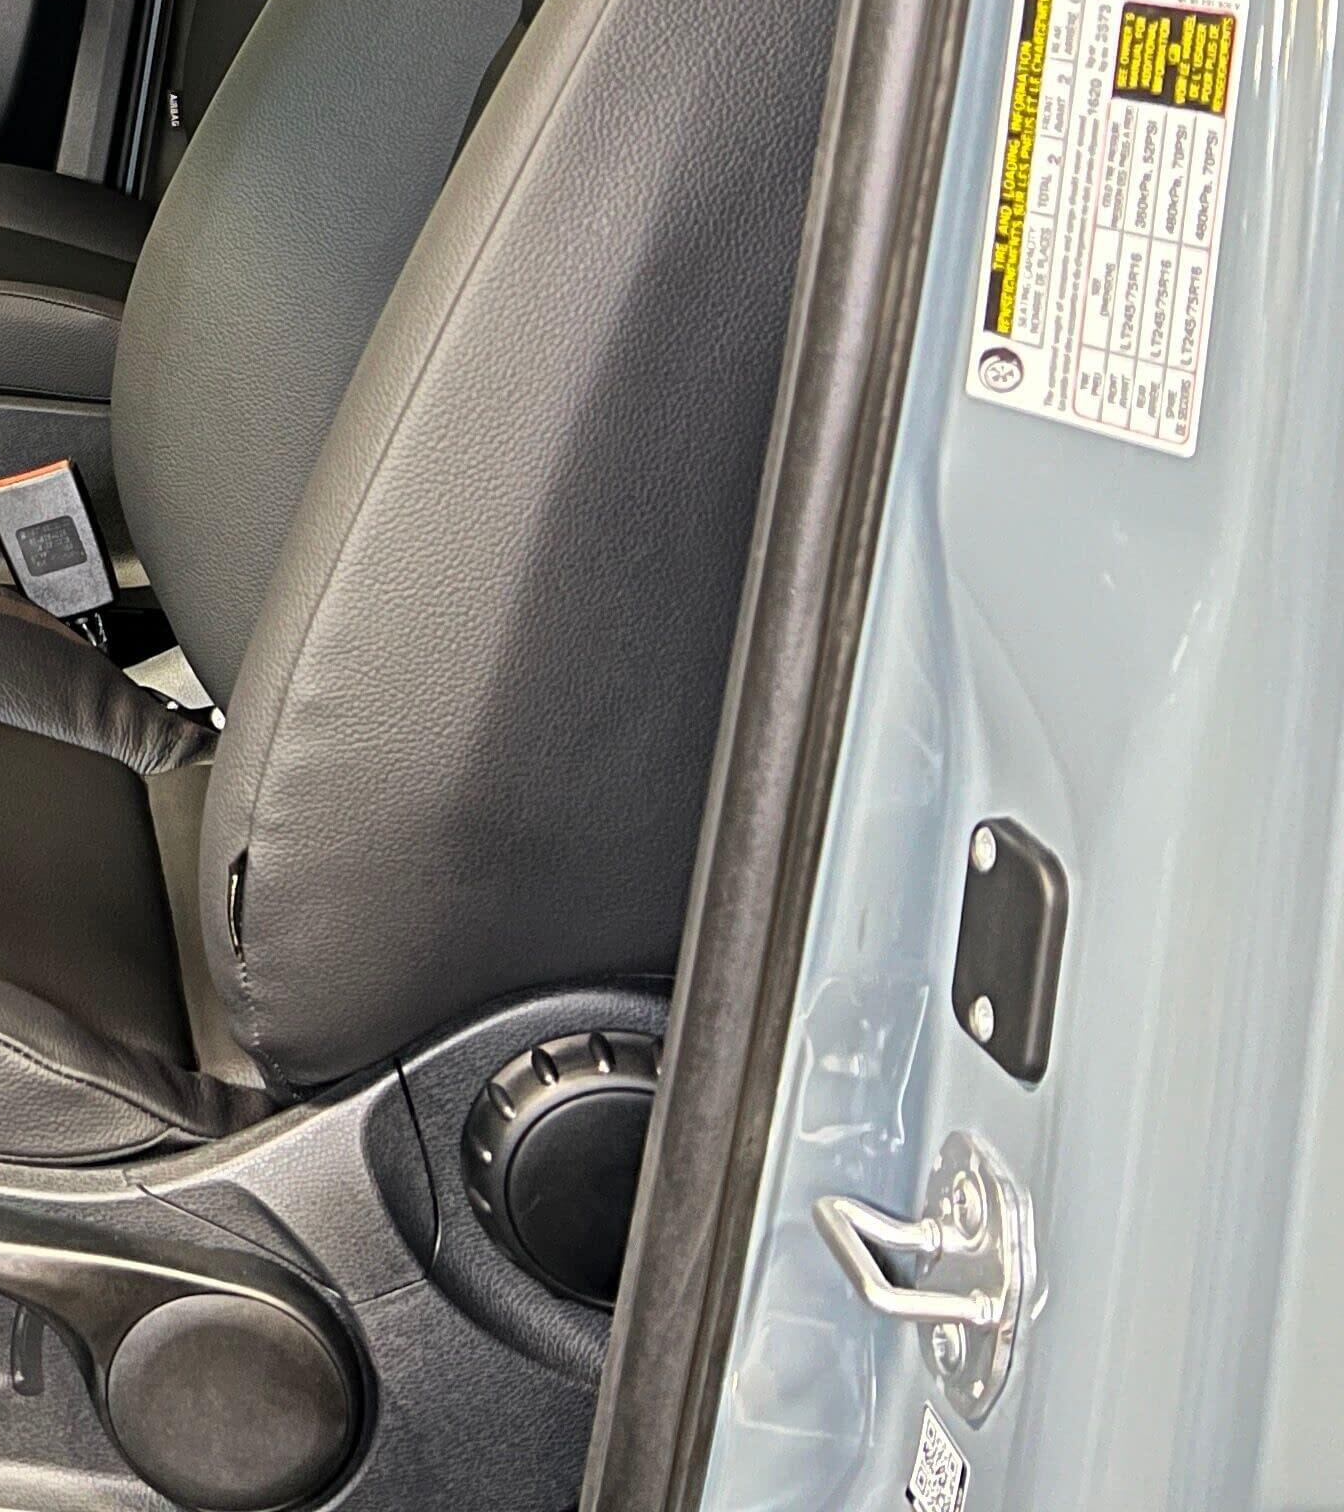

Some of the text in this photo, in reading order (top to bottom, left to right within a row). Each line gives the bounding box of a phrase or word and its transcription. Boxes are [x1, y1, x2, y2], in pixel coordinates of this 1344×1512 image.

[1133, 16, 1146, 39] FOR
[1027, 76, 1040, 92] LE
[1057, 73, 1071, 85] 2
[1200, 23, 1219, 102] POUR PLUS DE
[169, 93, 180, 127] AIRBAG
[1025, 95, 1038, 113] ET
[1085, 77, 1102, 116] 1620
[992, 40, 1032, 271] TIRE AND LOADING INFORMATION
[1019, 116, 1035, 159] PNEUS
[1142, 119, 1158, 164] 52PSI
[1171, 124, 1188, 169] 70PSI
[1202, 129, 1219, 176] 70PSI
[1016, 161, 1030, 186] LES
[1037, 152, 1061, 208] TOTAL 2
[1012, 190, 1027, 216] SUR
[1118, 251, 1143, 351] LT245/75R16
[1148, 258, 1172, 359] LT245/75R16
[1179, 264, 1204, 366] LT245/75R16
